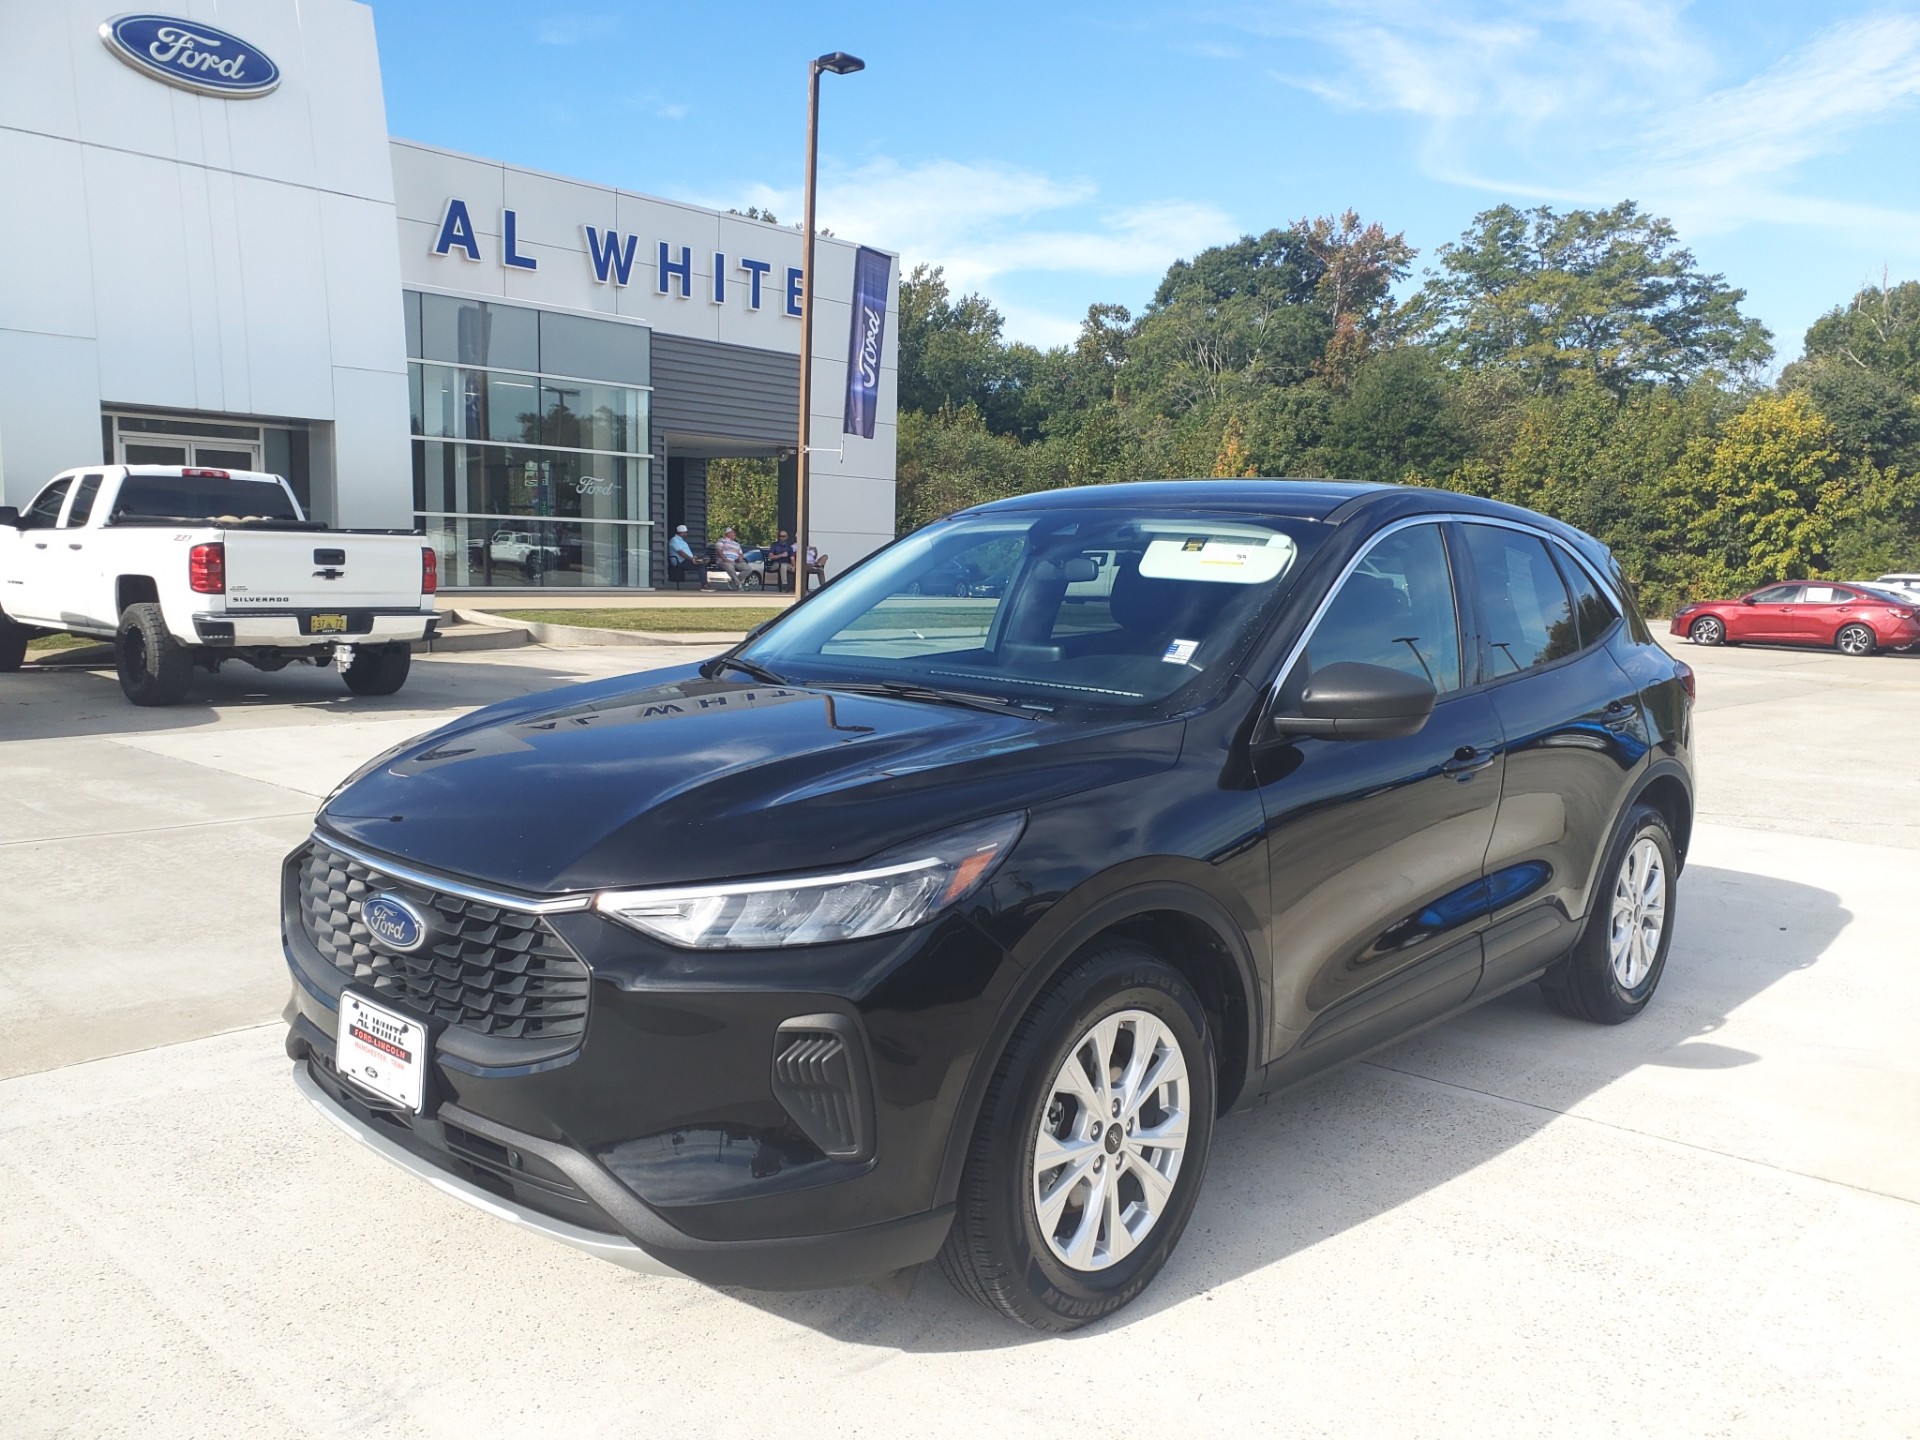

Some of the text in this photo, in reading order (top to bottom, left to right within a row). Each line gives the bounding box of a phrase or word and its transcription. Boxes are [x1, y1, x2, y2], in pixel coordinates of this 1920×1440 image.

[149, 26, 245, 80] Ford
[433, 197, 804, 318] AL WHITE
[858, 306, 881, 388] Ford
[575, 475, 614, 496] Ford
[370, 904, 406, 940] Ford
[1042, 1279, 1143, 1316] IRONMAN
